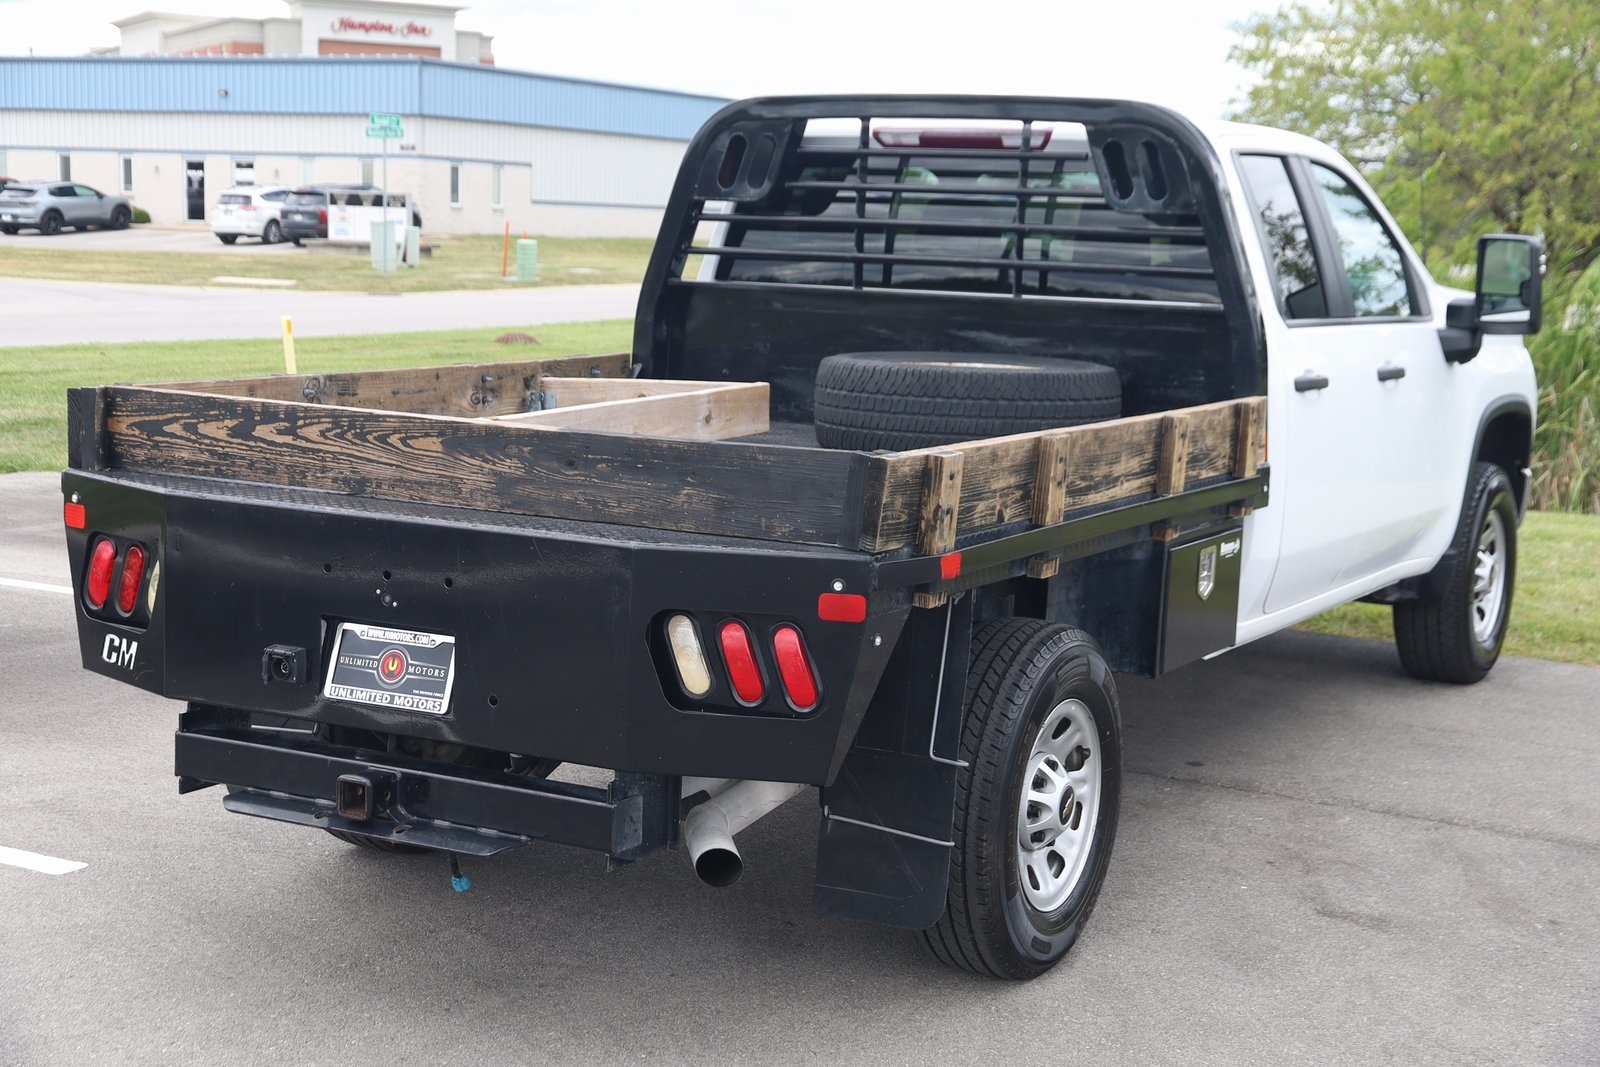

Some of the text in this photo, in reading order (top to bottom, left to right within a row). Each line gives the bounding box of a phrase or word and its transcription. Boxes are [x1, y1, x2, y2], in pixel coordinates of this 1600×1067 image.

[331, 16, 432, 38] Hampton Inn
[102, 633, 138, 670] CM
[340, 656, 445, 678] UNLIMITED MOTORS
[330, 686, 441, 712] UNLIMITED MOTORS
